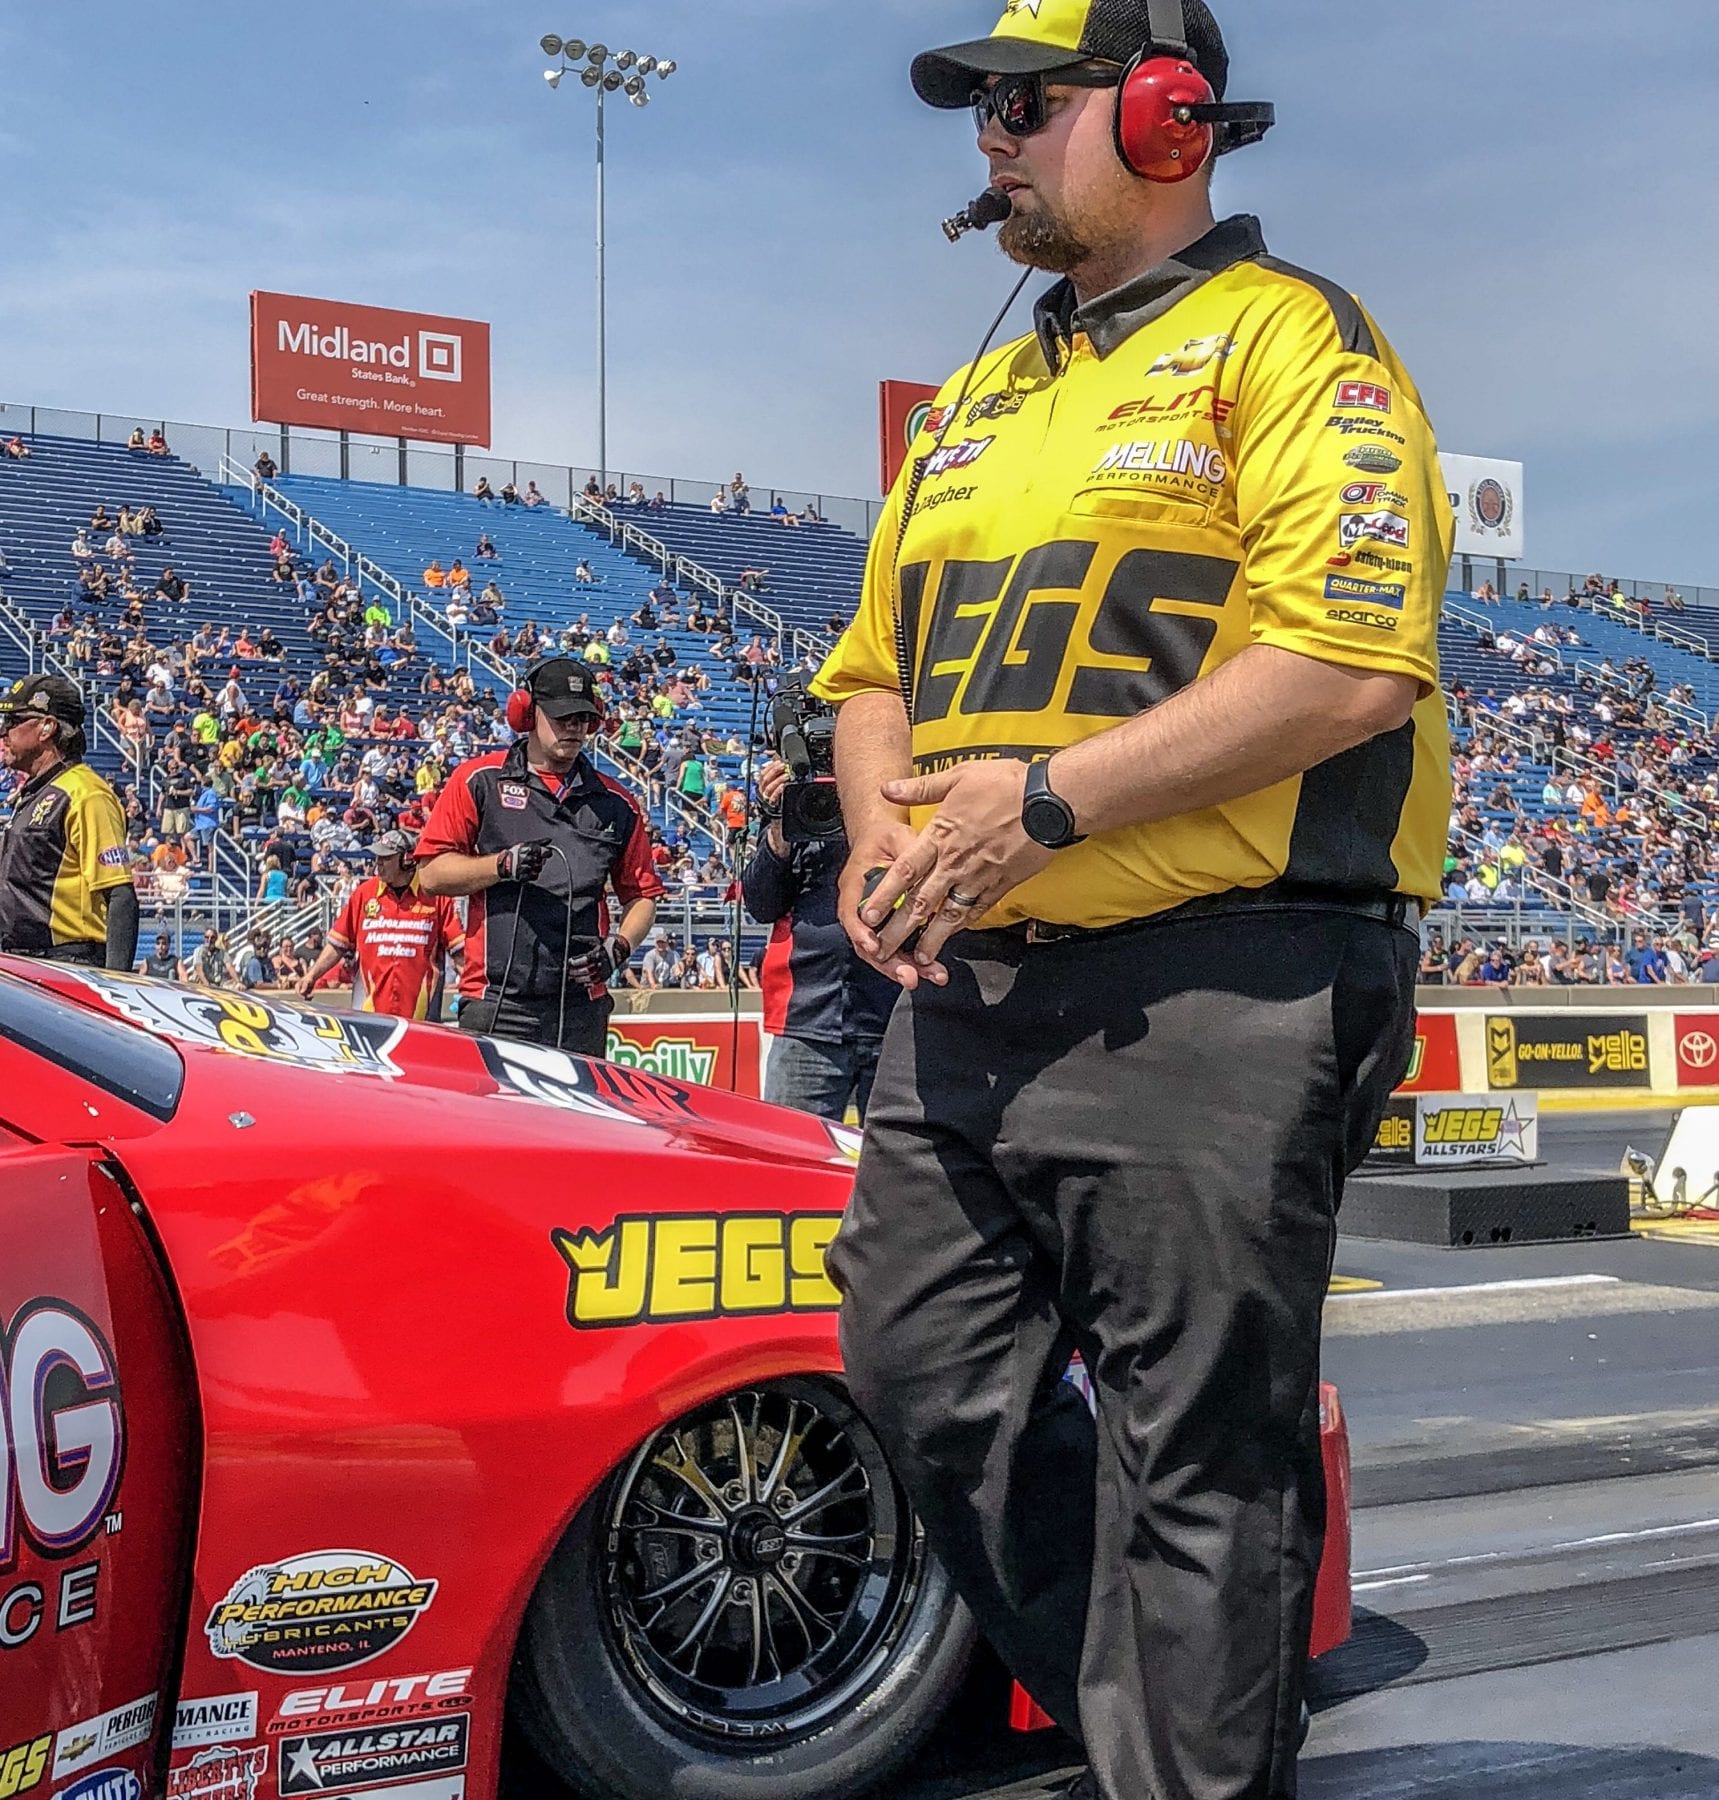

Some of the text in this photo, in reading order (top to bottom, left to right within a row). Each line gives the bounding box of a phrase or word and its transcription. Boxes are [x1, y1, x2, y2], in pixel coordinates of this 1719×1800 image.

[278, 320, 410, 368] Midland
[351, 368, 384, 382] States
[297, 388, 446, 417] Great strength. More heart.
[1107, 385, 1236, 422] ELITE
[1338, 382, 1390, 409] CFE
[1094, 410, 1215, 432] MOTORSPORTS
[1339, 424, 1406, 445] Trucking
[1091, 439, 1226, 483] MELLING
[1086, 472, 1220, 498] PERFORMANCE
[1326, 609, 1397, 627] sparco
[503, 785, 525, 797] FOX
[365, 932, 429, 945] Management
[377, 944, 416, 957] Services
[1424, 1108, 1503, 1143] JEGS
[1422, 1144, 1497, 1156] ALLSTARS
[552, 1212, 845, 1329] JEGS
[271, 1563, 392, 1593] HIGH
[218, 1587, 428, 1625] PERFORMANCE
[223, 1616, 409, 1648] LUBRICANTS
[272, 1640, 371, 1659] MANTENO, IL
[279, 1668, 473, 1716] ELITE
[268, 1701, 434, 1732] MOTORSPORTS
[318, 1724, 460, 1760] ALLSTAR
[320, 1745, 460, 1777] PERFORMANCE
